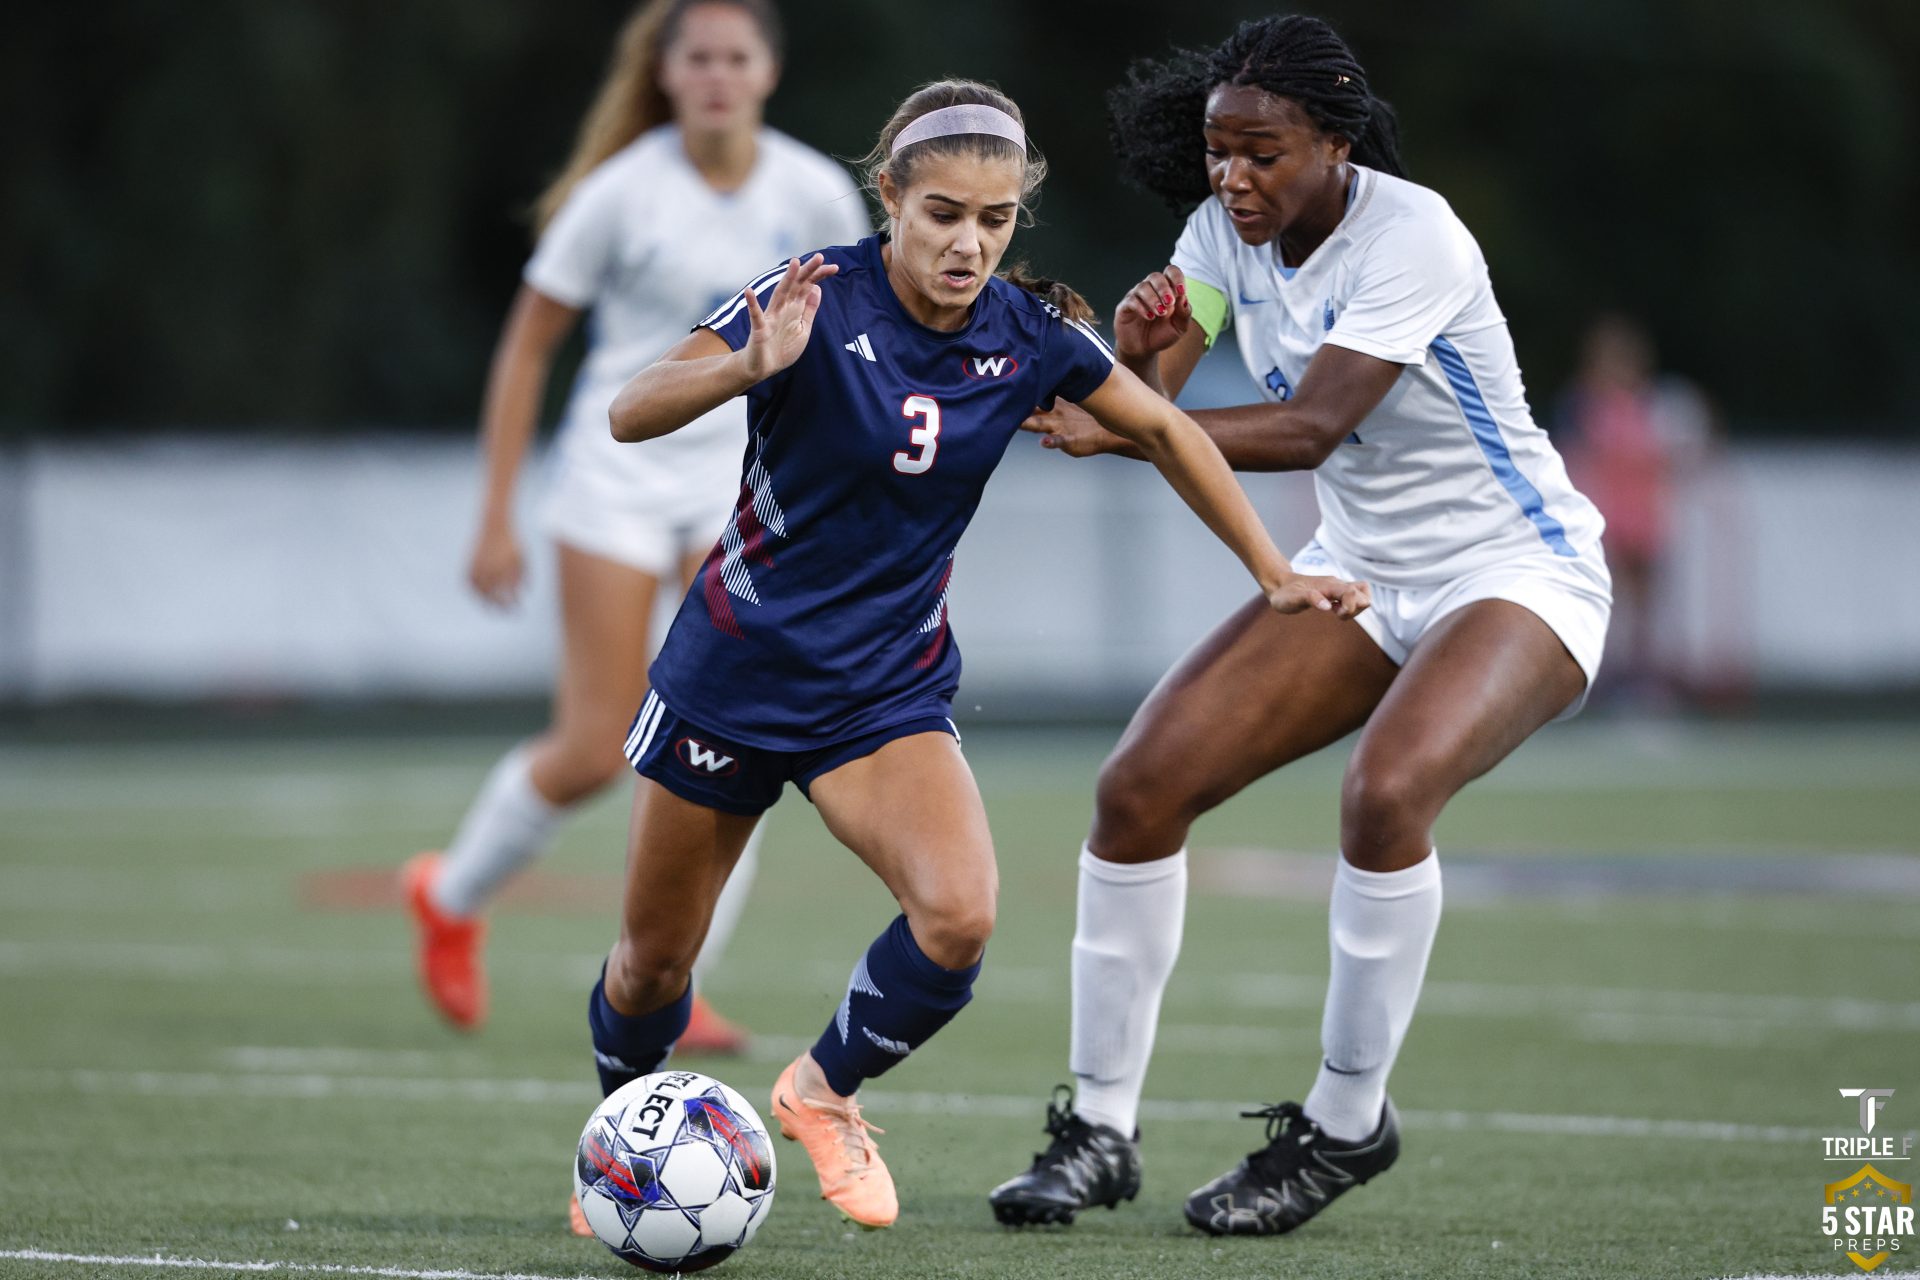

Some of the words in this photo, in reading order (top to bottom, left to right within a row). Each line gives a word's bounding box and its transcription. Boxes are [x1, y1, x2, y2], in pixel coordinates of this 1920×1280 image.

[973, 357, 1008, 376] W
[893, 394, 941, 475] 3
[688, 739, 734, 772] W
[632, 1072, 699, 1141] SELECT
